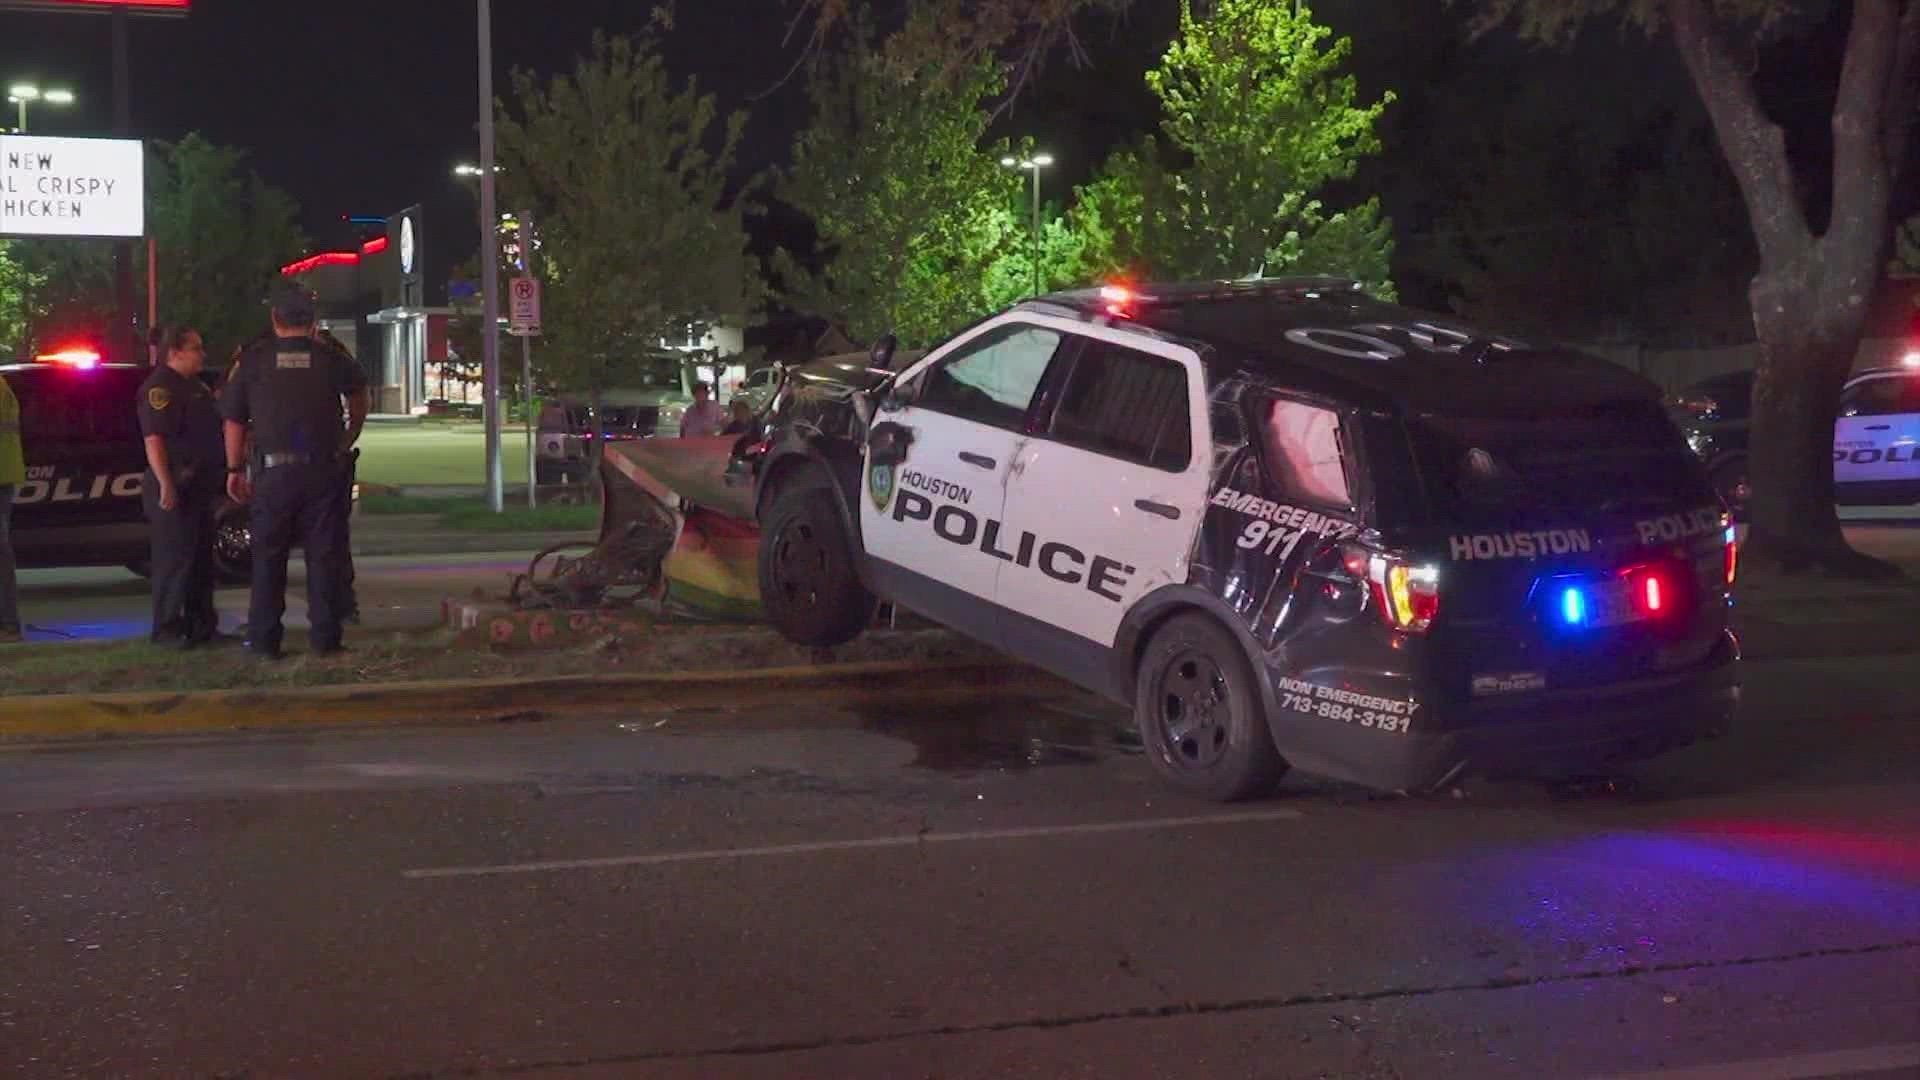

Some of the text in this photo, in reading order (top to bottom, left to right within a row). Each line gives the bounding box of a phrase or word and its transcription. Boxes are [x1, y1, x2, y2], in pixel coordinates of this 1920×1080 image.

[9, 151, 52, 170] NEW
[37, 175, 115, 196] CRISPY
[901, 468, 972, 505] HOUSTON
[1211, 486, 1359, 540] EMERGENCY
[892, 487, 1136, 603] POLICE
[1236, 520, 1302, 561] 911
[1449, 528, 1591, 561] HOUSTON
[1279, 676, 1420, 716] NON EMERGENCY
[1281, 692, 1412, 734] 713-884-3131
